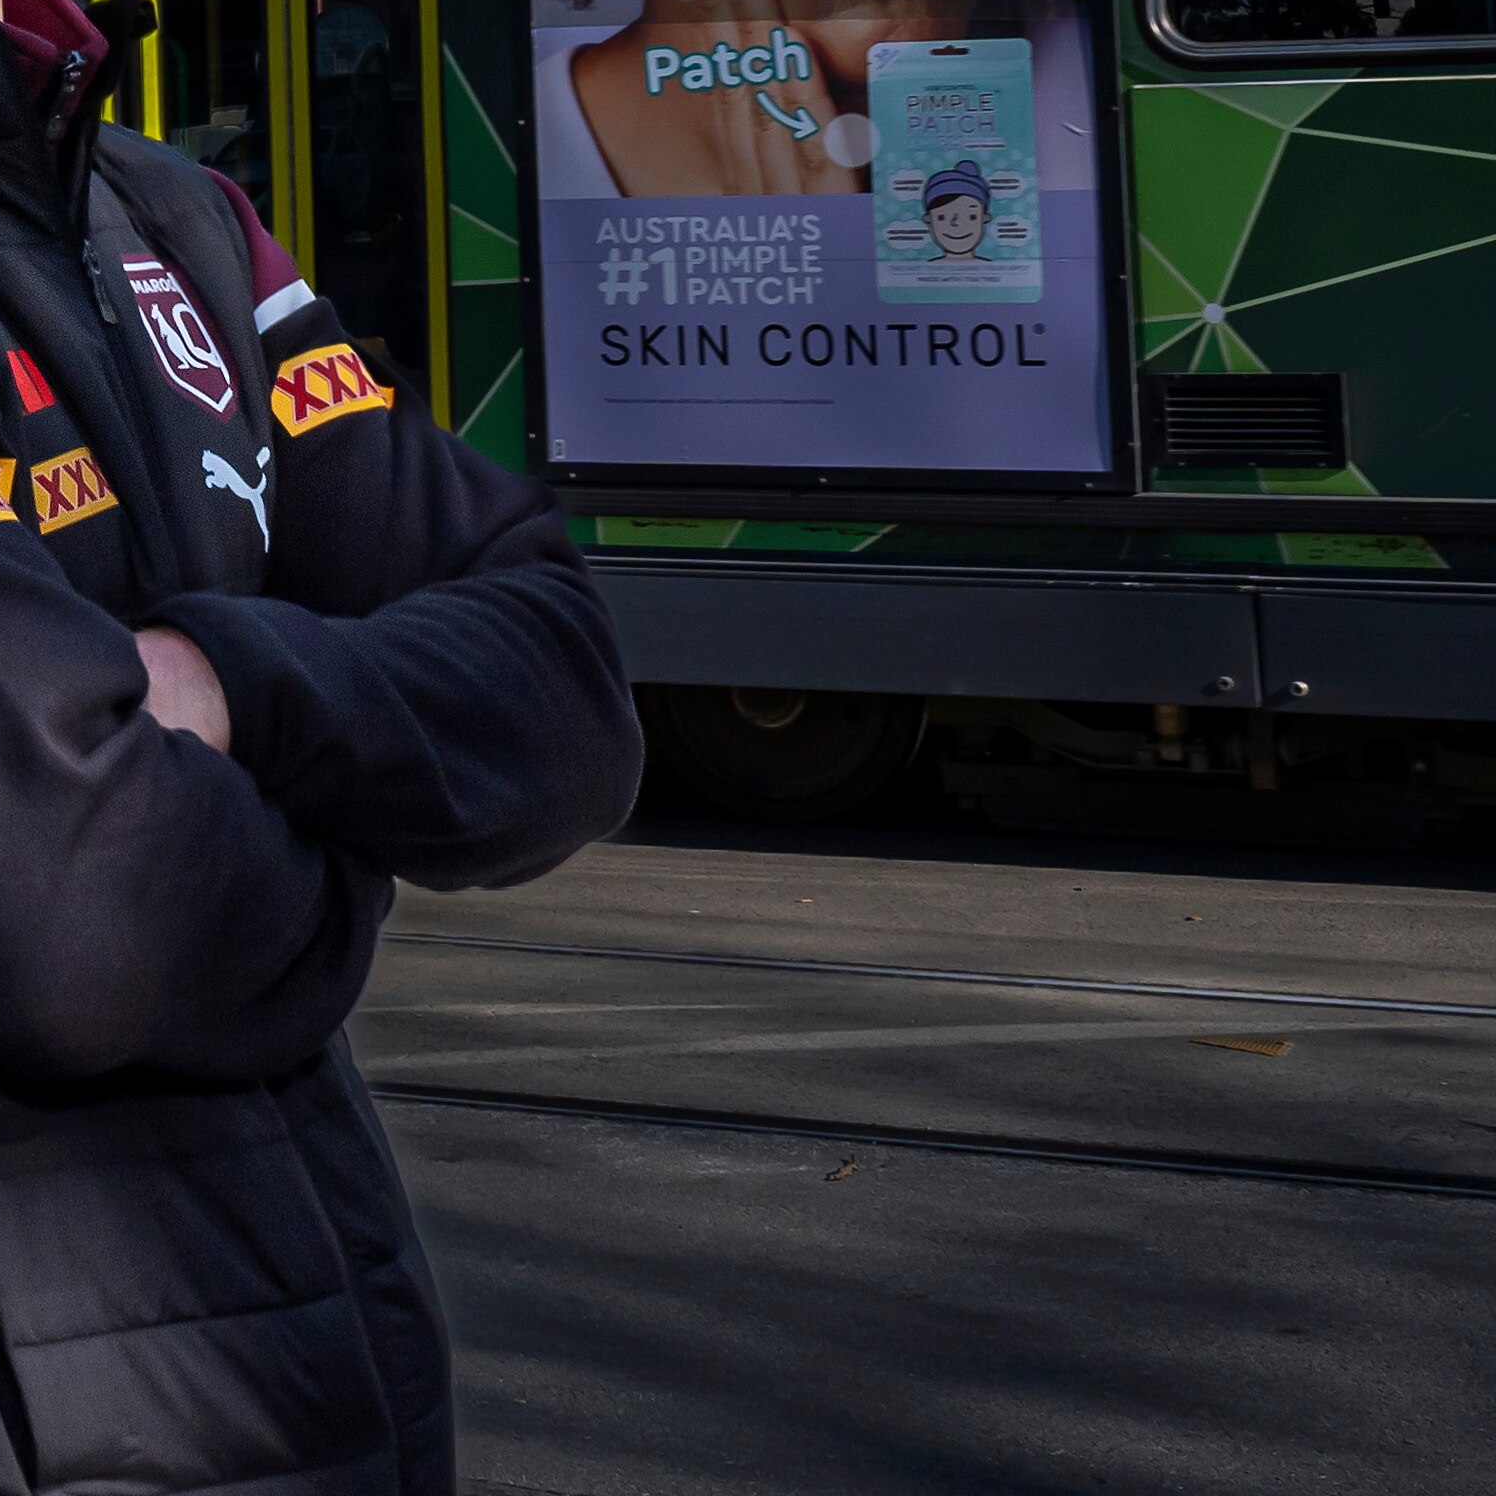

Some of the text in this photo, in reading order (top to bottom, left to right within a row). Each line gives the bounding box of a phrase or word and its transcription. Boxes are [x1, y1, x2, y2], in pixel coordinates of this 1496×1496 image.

[645, 28, 810, 95] Patch
[907, 92, 995, 112] PIMPLE
[908, 115, 996, 134] PATCH
[596, 214, 822, 244] AUSTRALIA'S
[686, 245, 822, 273] PIMPLE
[598, 247, 676, 305] #1
[687, 276, 815, 305] PATCH
[600, 323, 1047, 367] SKIN CONTROL
[33, 456, 109, 525] XXX
